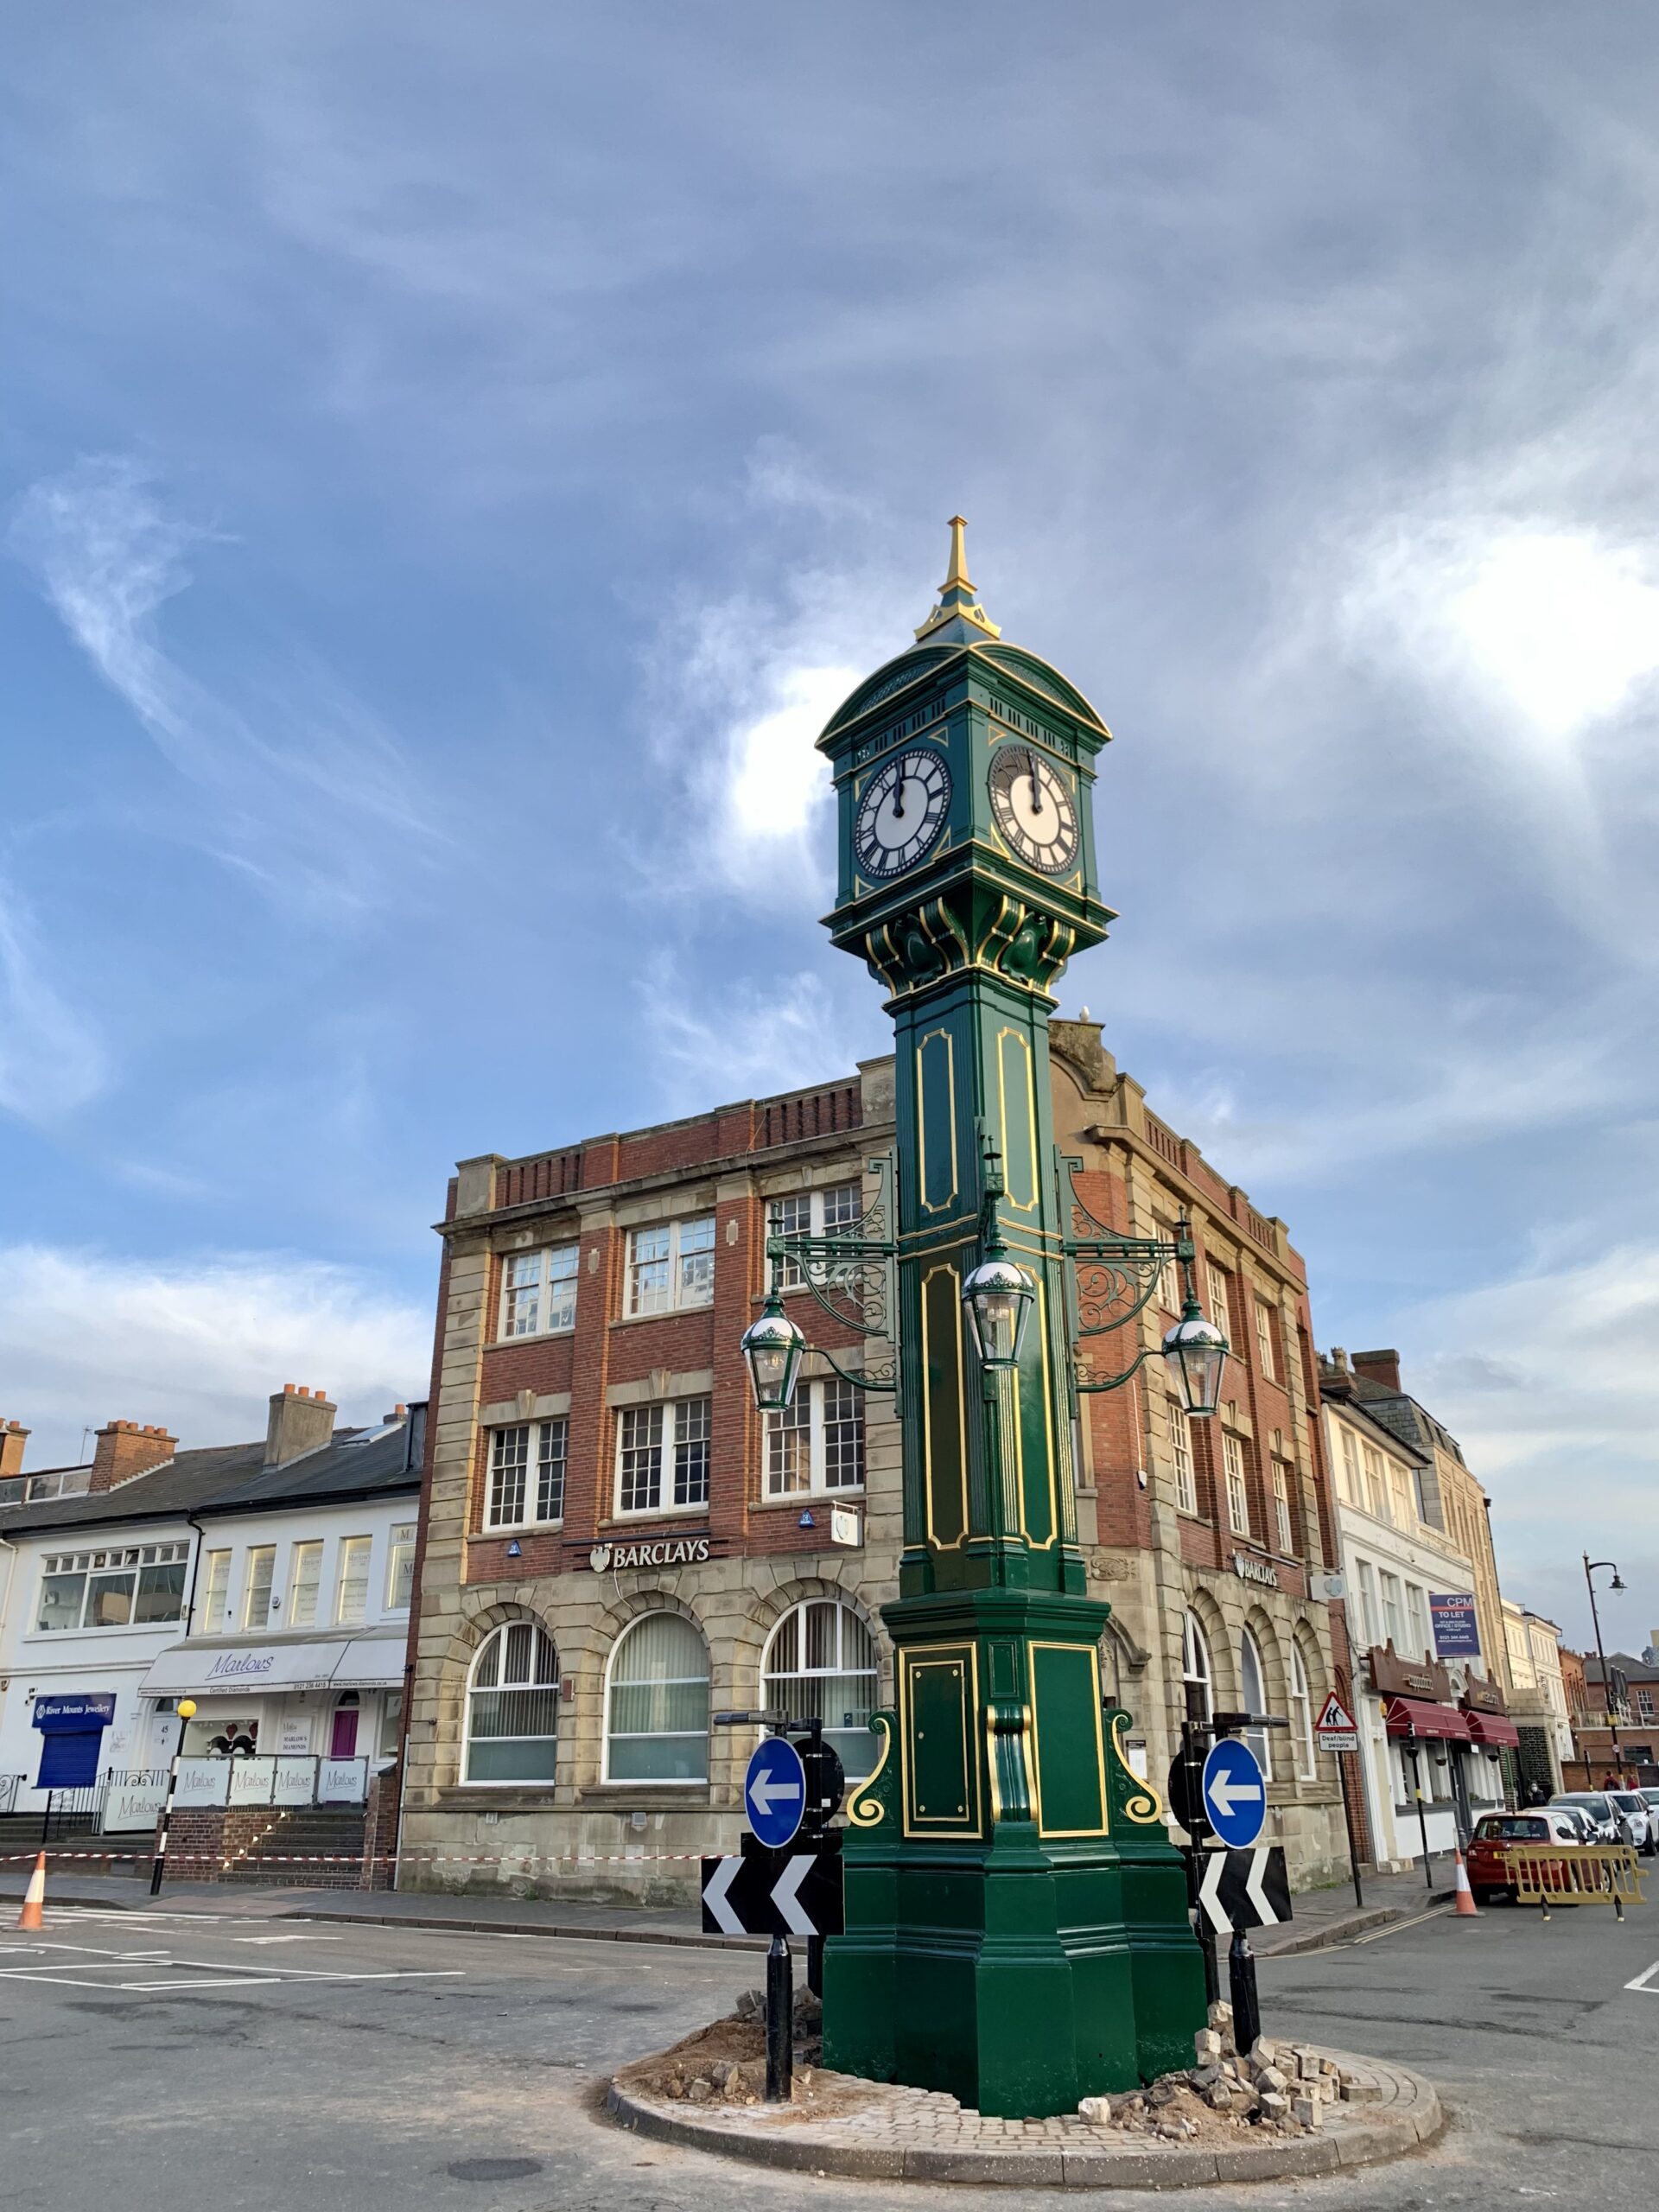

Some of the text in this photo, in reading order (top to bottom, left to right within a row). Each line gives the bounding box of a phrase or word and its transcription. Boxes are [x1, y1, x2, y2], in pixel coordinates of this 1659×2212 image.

[613, 1539, 709, 1568] BARCLAYS
[1244, 1559, 1277, 1586] BARCLAYS
[1446, 1597, 1473, 1608] CPM
[207, 1653, 274, 1678] Marlows
[46, 1704, 111, 1715] River Mounts Jewellery
[161, 1726, 168, 1734] 45
[183, 1770, 216, 1792] Marlows
[234, 1770, 270, 1792] Marlows
[277, 1770, 311, 1791] Marlows
[326, 1770, 357, 1791] Marlows
